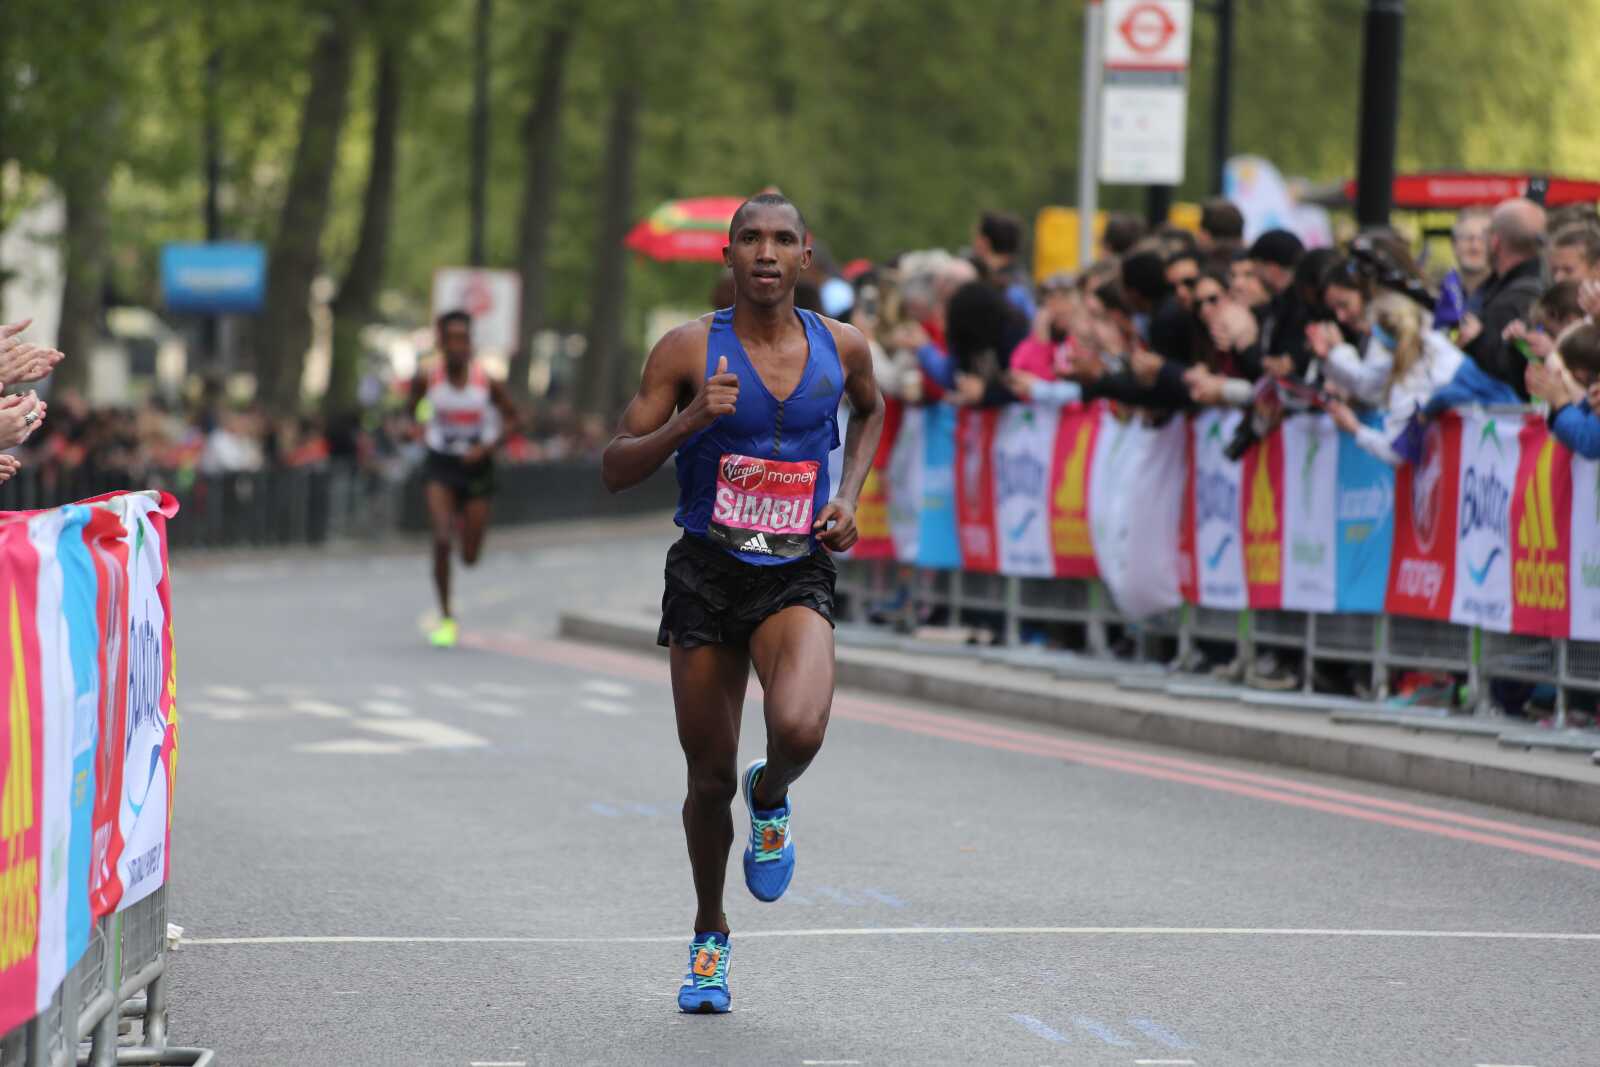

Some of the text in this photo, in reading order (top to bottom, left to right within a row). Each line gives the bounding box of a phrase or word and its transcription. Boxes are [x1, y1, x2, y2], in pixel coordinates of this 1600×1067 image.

[724, 460, 815, 486] Virgin money
[714, 487, 811, 529] SIMBU
[1515, 549, 1565, 610] adidas
